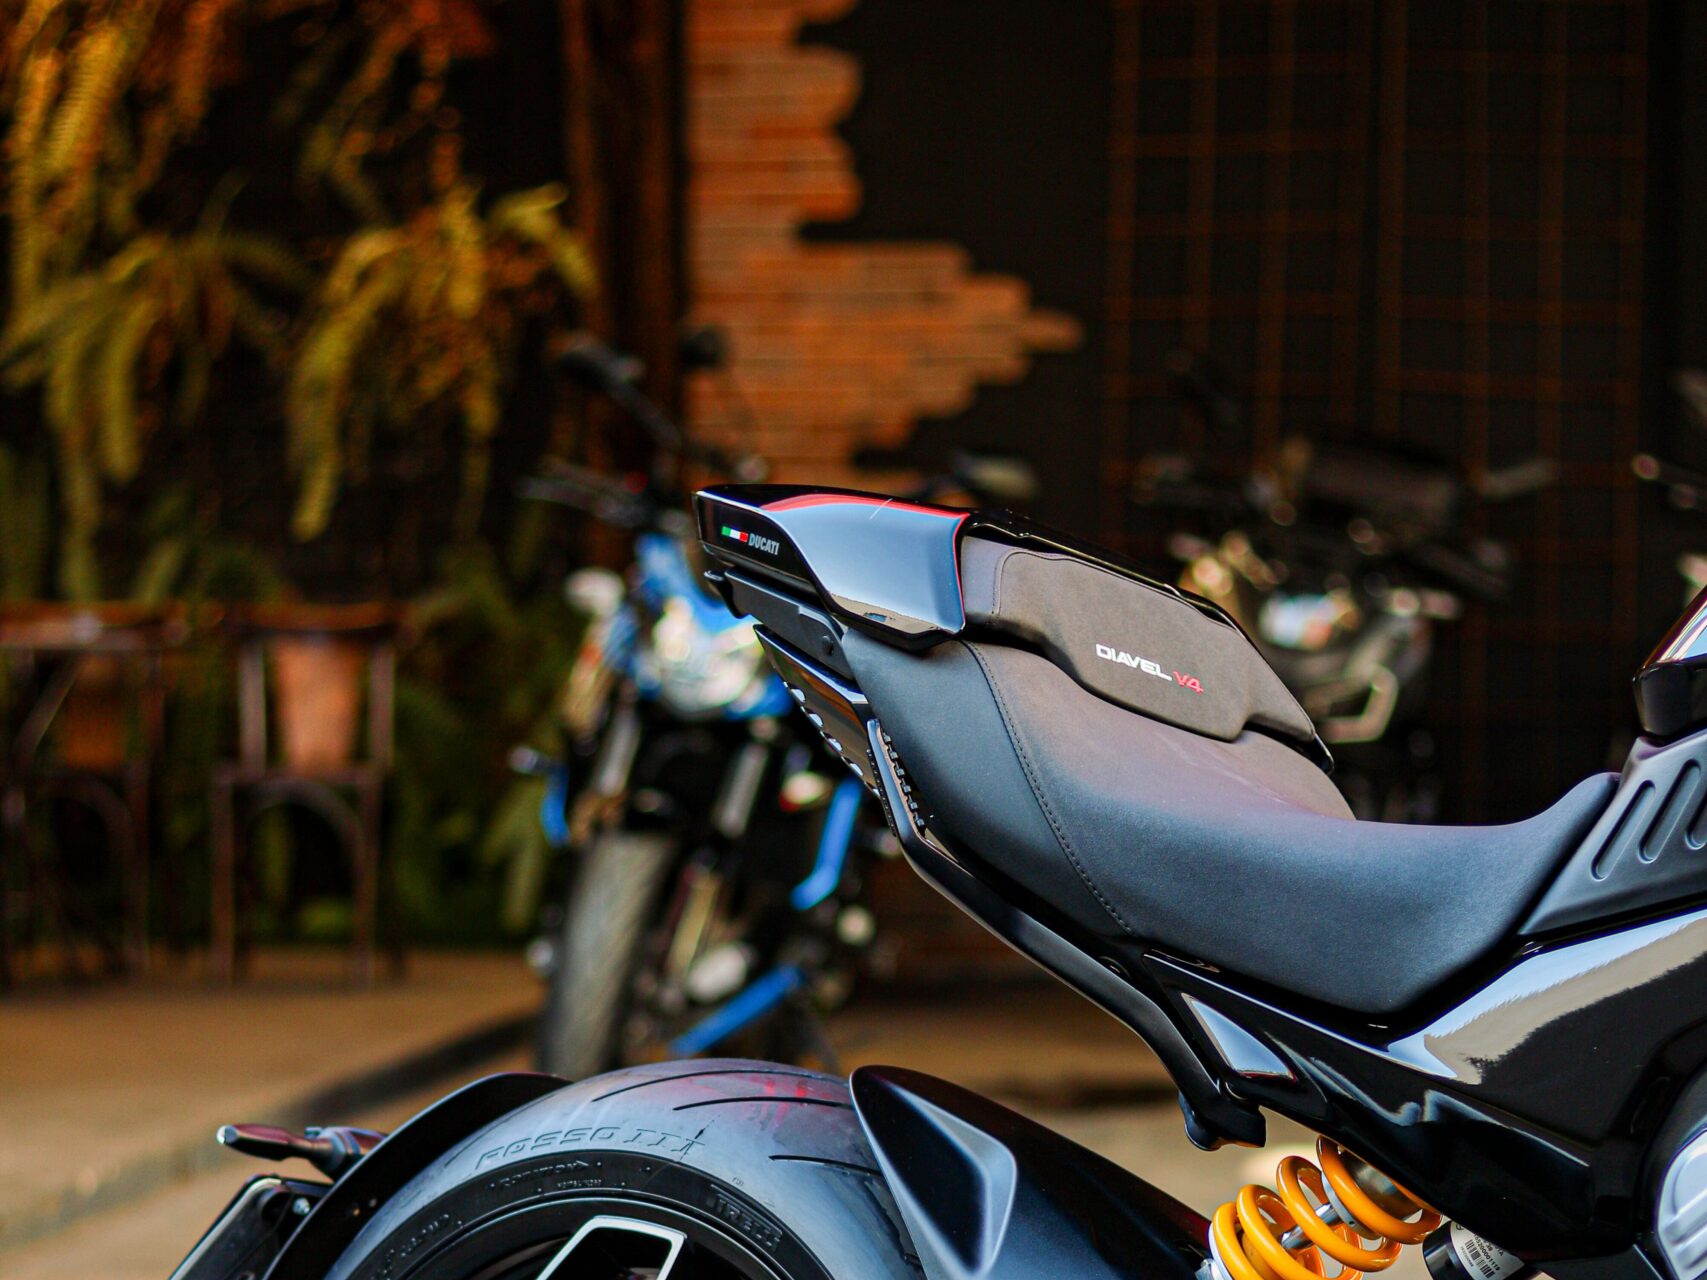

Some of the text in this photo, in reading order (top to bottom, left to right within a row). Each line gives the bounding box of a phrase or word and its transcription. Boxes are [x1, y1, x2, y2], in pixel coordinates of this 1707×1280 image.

[748, 533, 780, 556] DUCATI
[1095, 643, 1205, 695] DIAVEL V4
